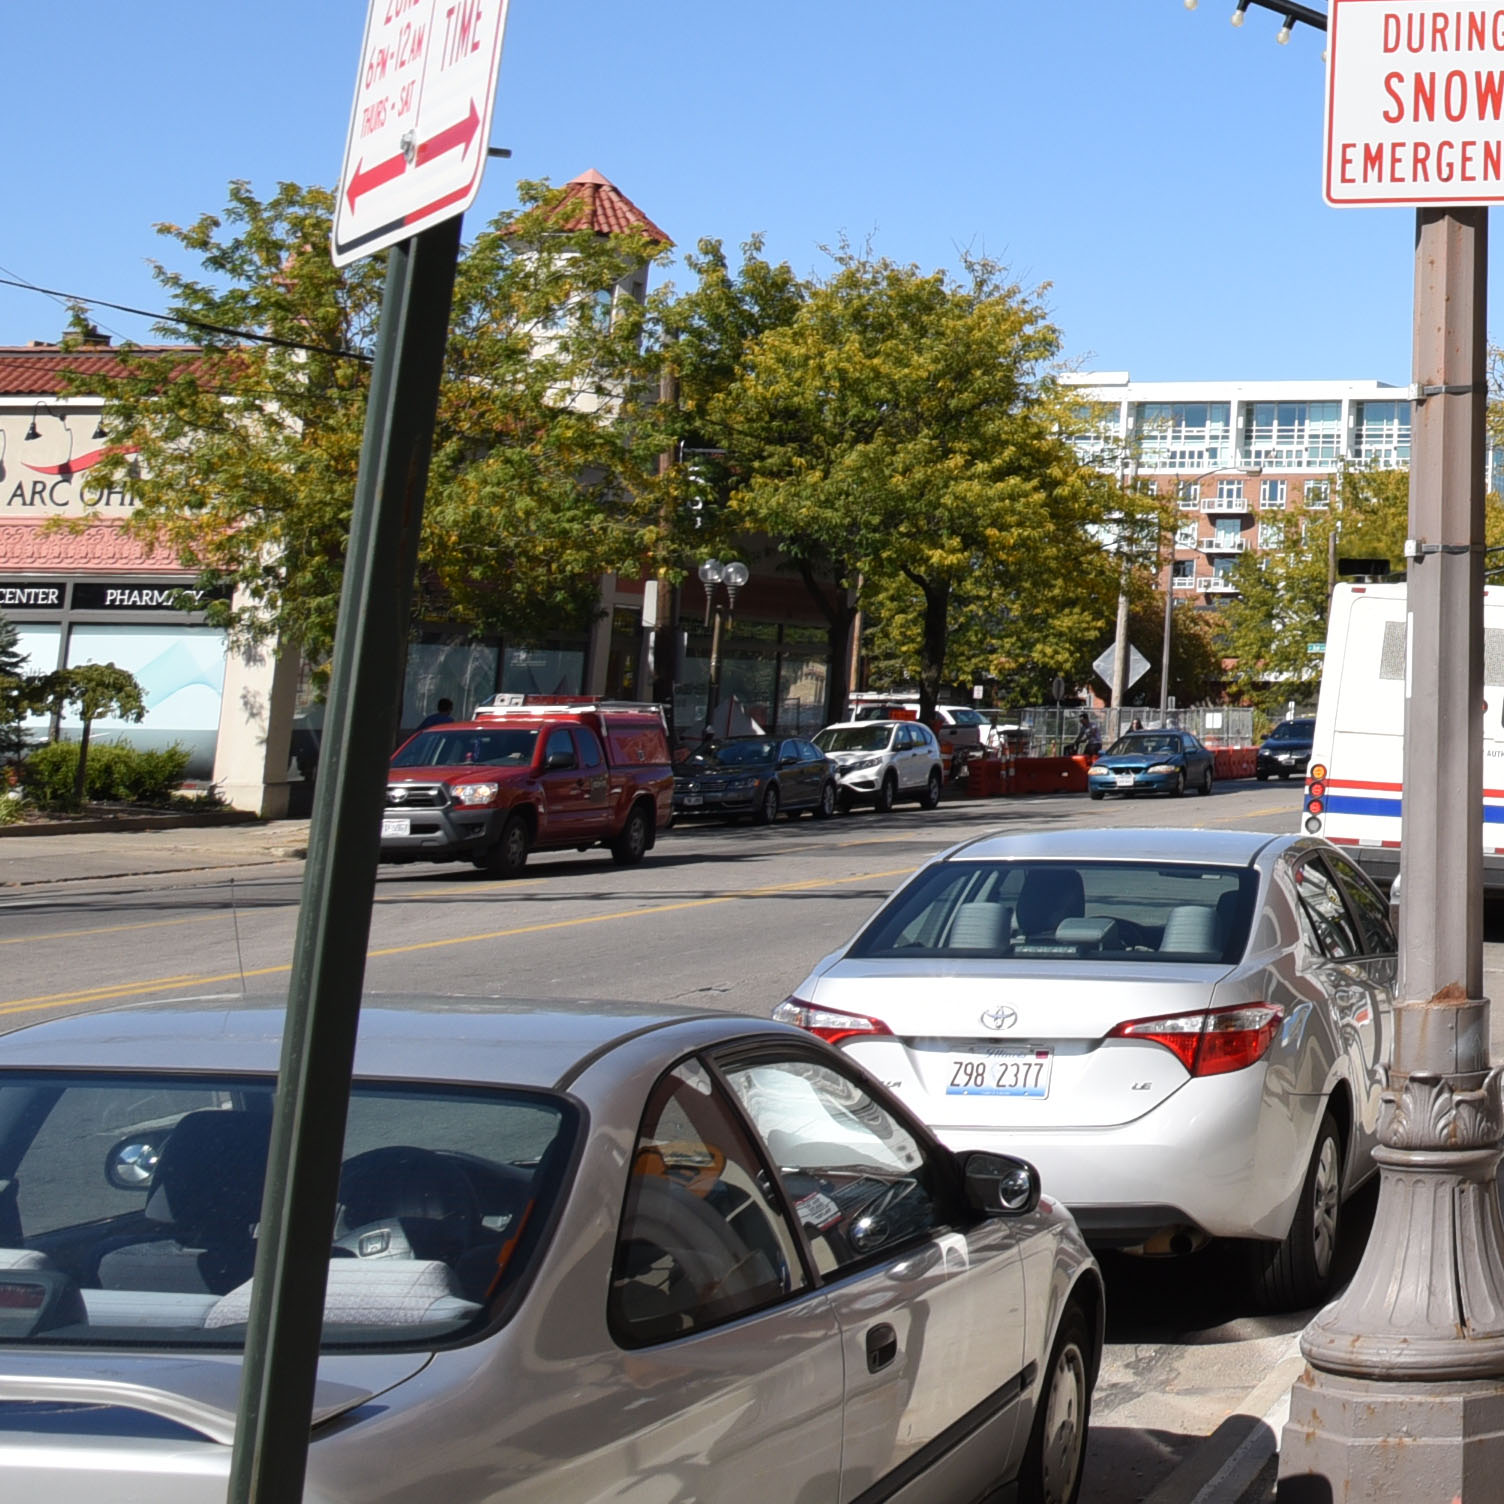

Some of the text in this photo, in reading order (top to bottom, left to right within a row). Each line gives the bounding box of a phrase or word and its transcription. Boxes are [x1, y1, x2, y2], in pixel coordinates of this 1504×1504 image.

[398, 79, 416, 117] SAT
[6, 480, 71, 507] ARC
[950, 1061, 1044, 1089] Z98 2377
[1131, 1082, 1152, 1091] LE
